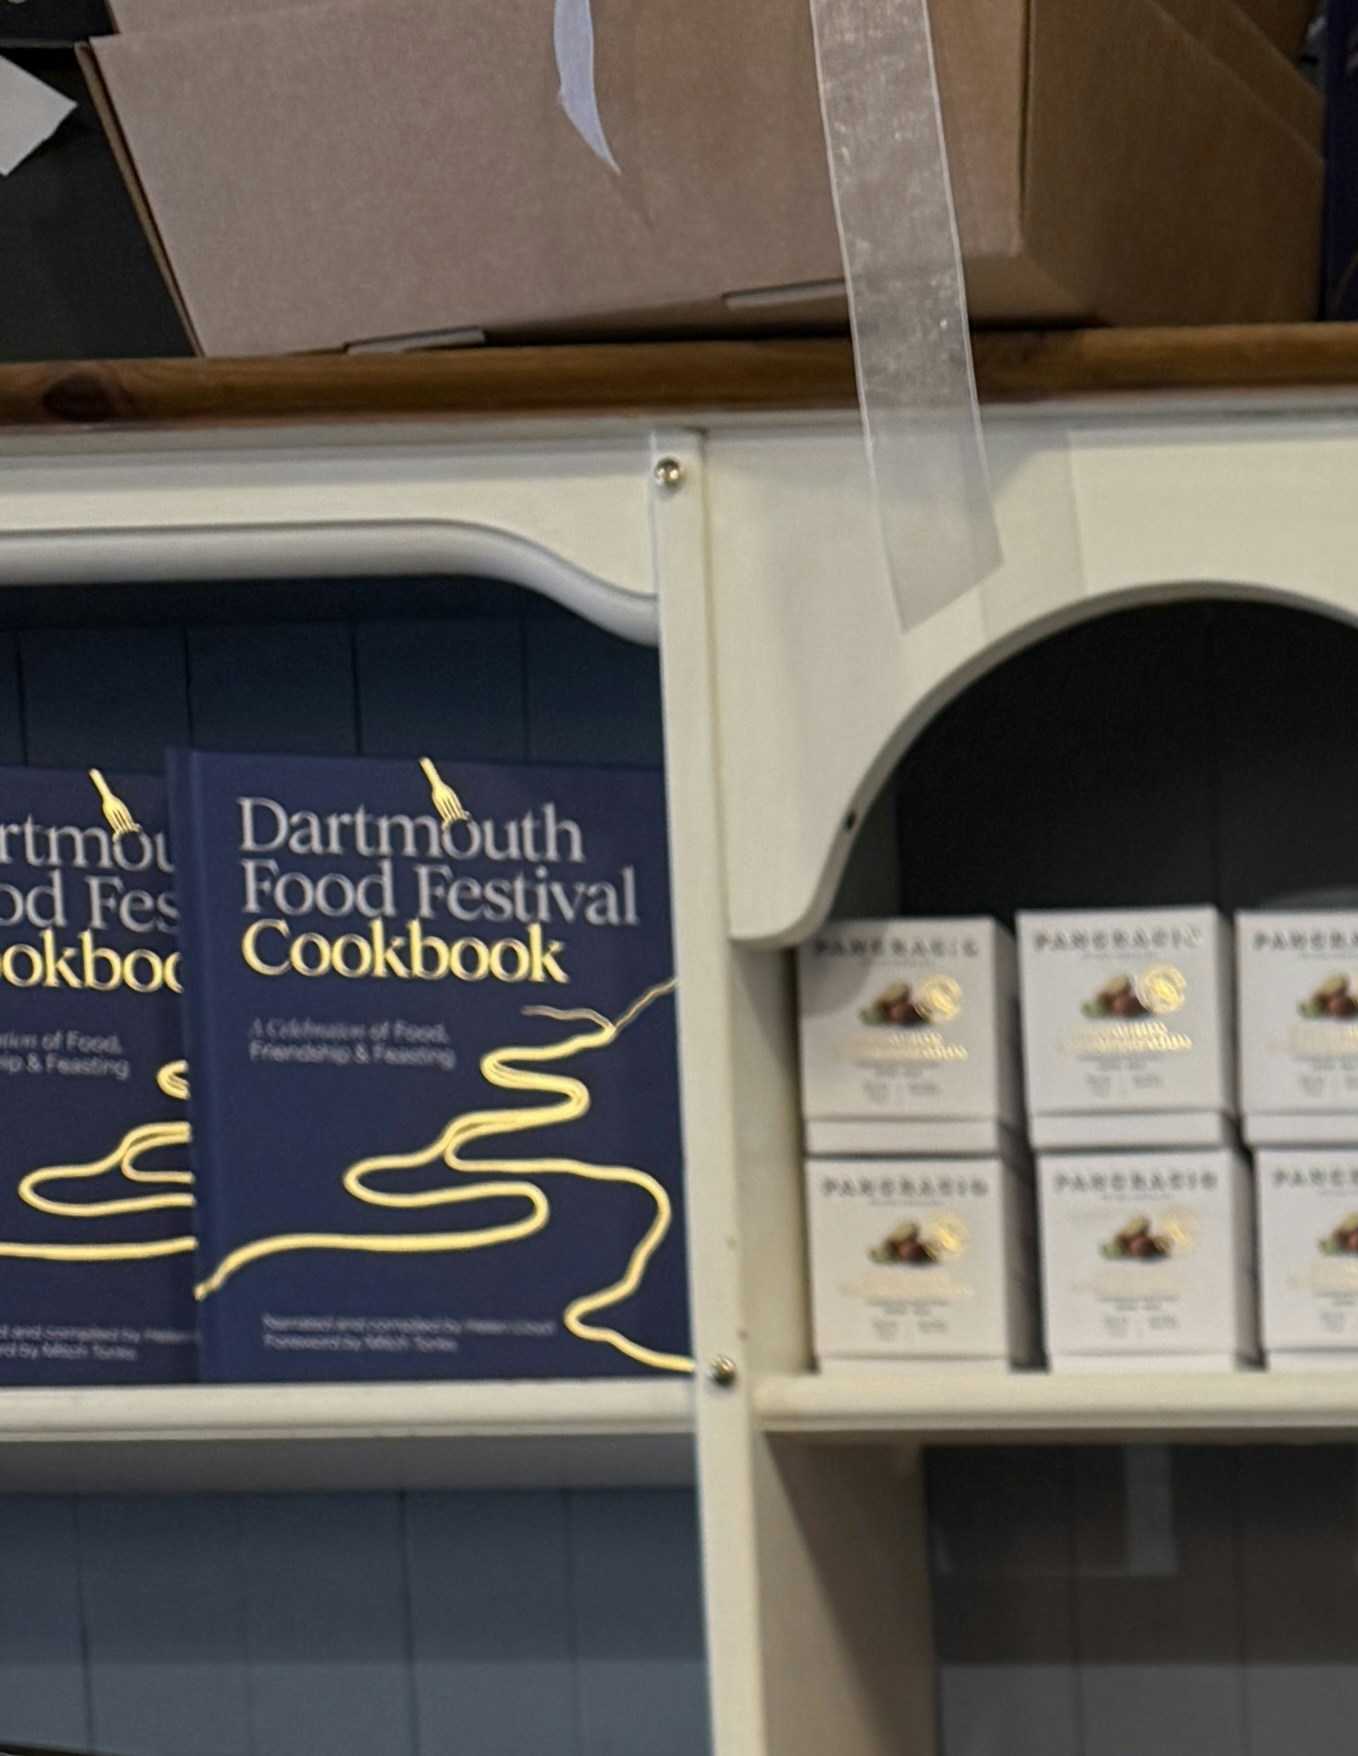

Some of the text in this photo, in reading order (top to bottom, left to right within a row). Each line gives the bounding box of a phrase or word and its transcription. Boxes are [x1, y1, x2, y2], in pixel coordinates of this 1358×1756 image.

[237, 797, 586, 865] Dartmouth
[240, 857, 640, 926] Food Festival
[241, 919, 571, 985] Cookbook
